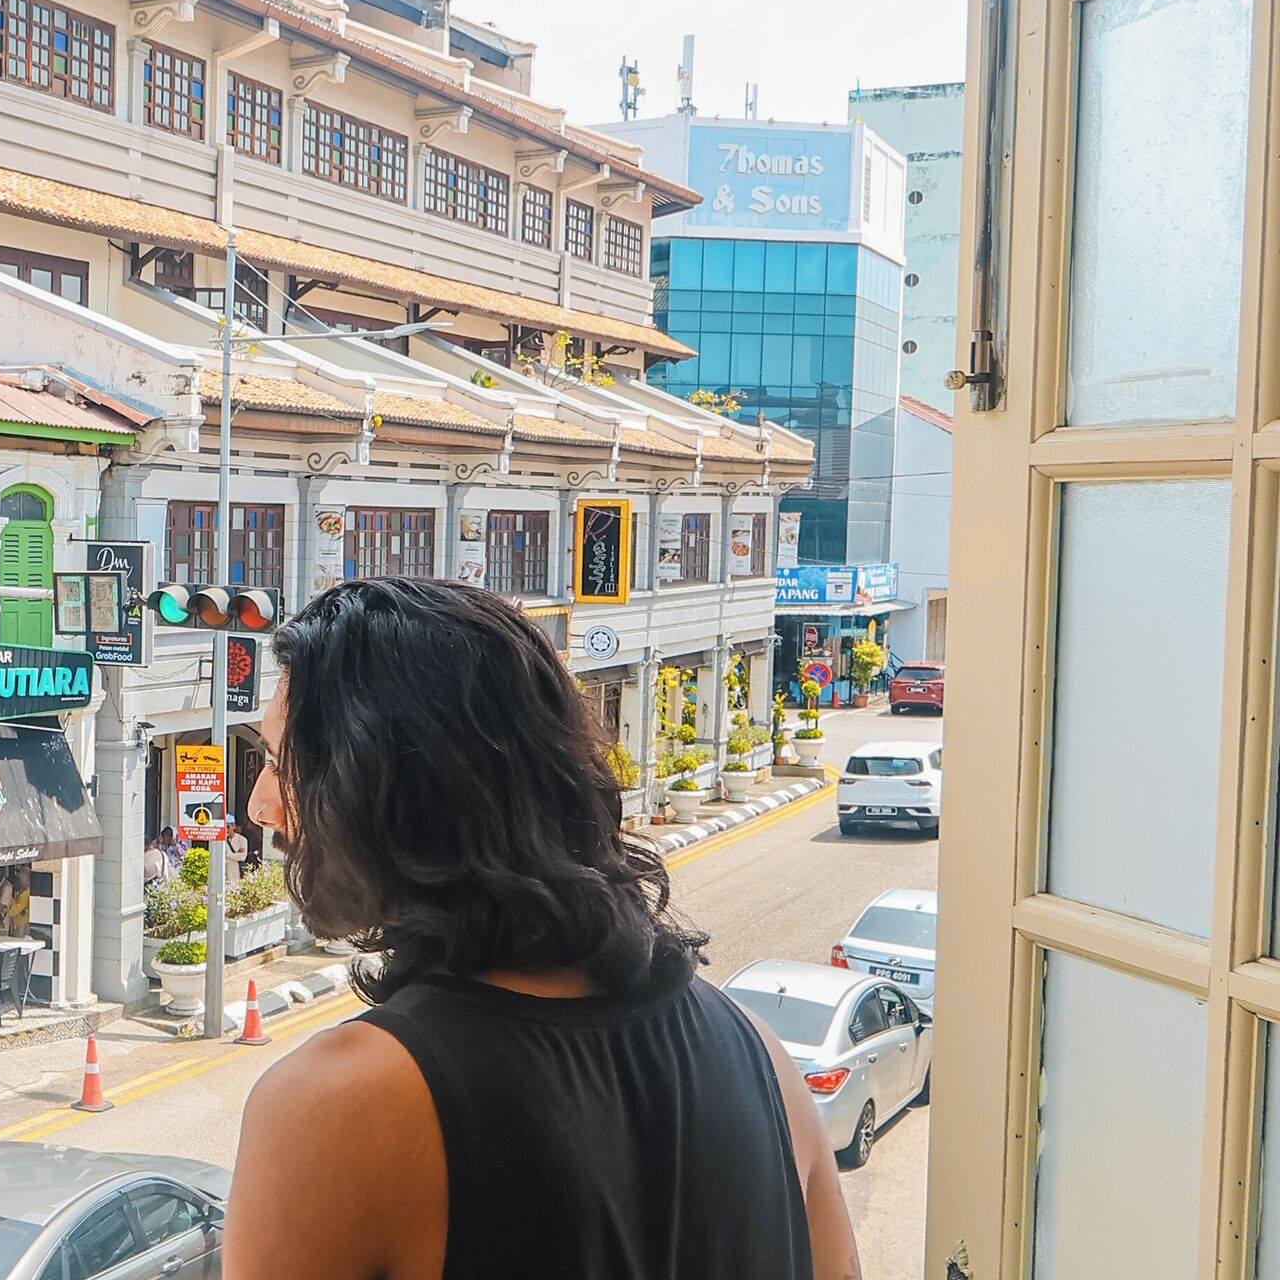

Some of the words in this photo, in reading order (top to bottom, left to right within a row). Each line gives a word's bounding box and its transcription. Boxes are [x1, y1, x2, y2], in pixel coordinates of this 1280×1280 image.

[718, 143, 824, 177] Thomas
[712, 184, 735, 213] &
[747, 185, 822, 215] Sons
[775, 578, 798, 587] DAR
[95, 652, 133, 661] GrabFood
[226, 694, 249, 706] naga
[892, 971, 911, 982] 4091
